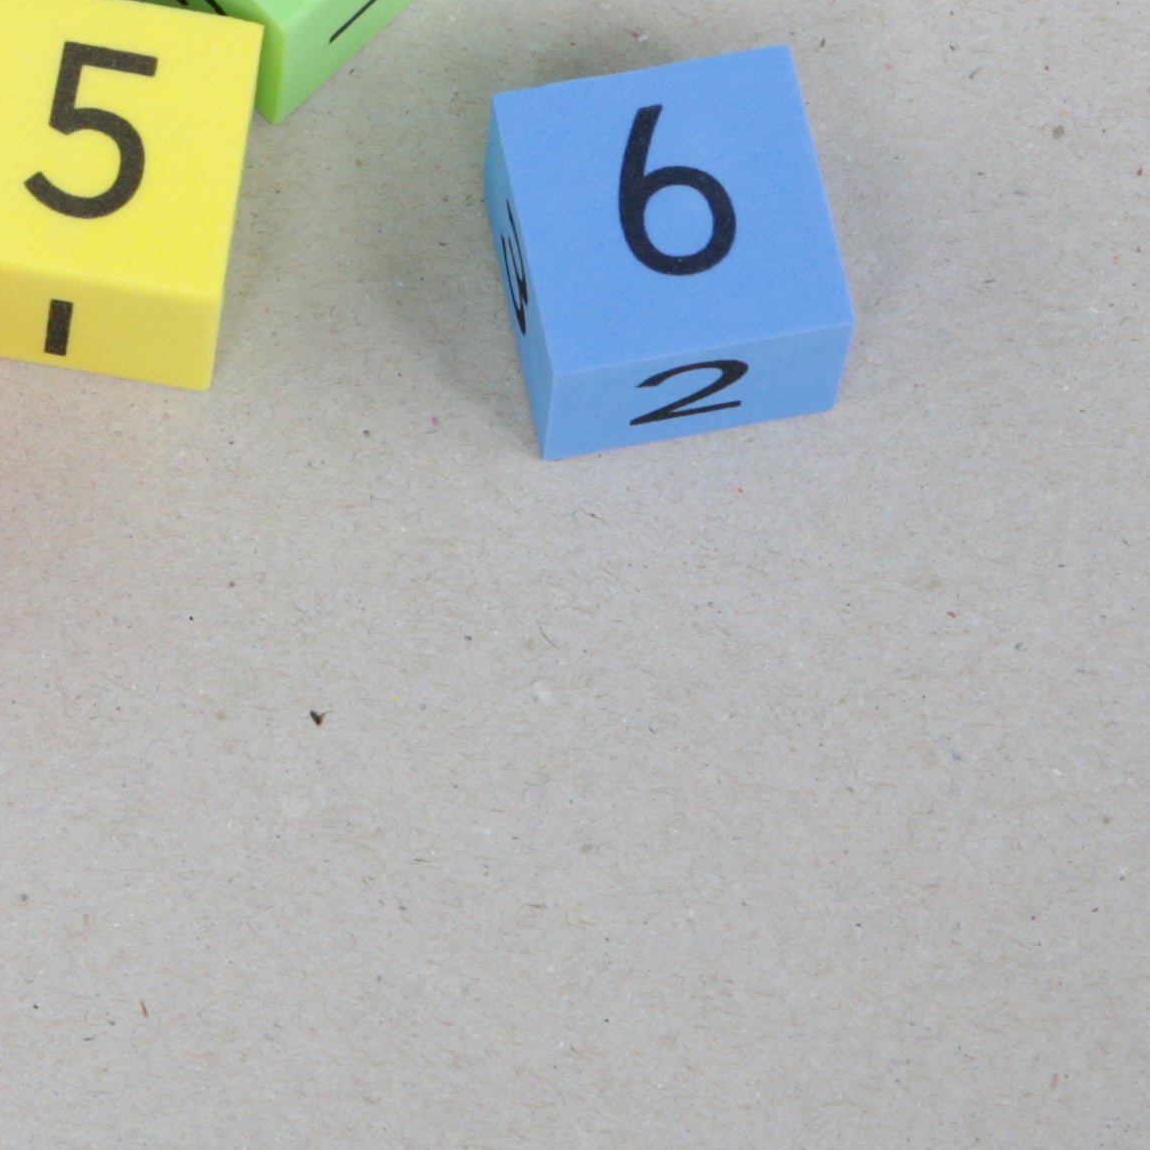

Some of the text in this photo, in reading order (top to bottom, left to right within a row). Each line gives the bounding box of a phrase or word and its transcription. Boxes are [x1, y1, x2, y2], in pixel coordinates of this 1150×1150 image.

[24, 40, 158, 220] 5
[619, 105, 737, 276] 6
[43, 298, 74, 357] 1
[630, 359, 749, 427] 2
